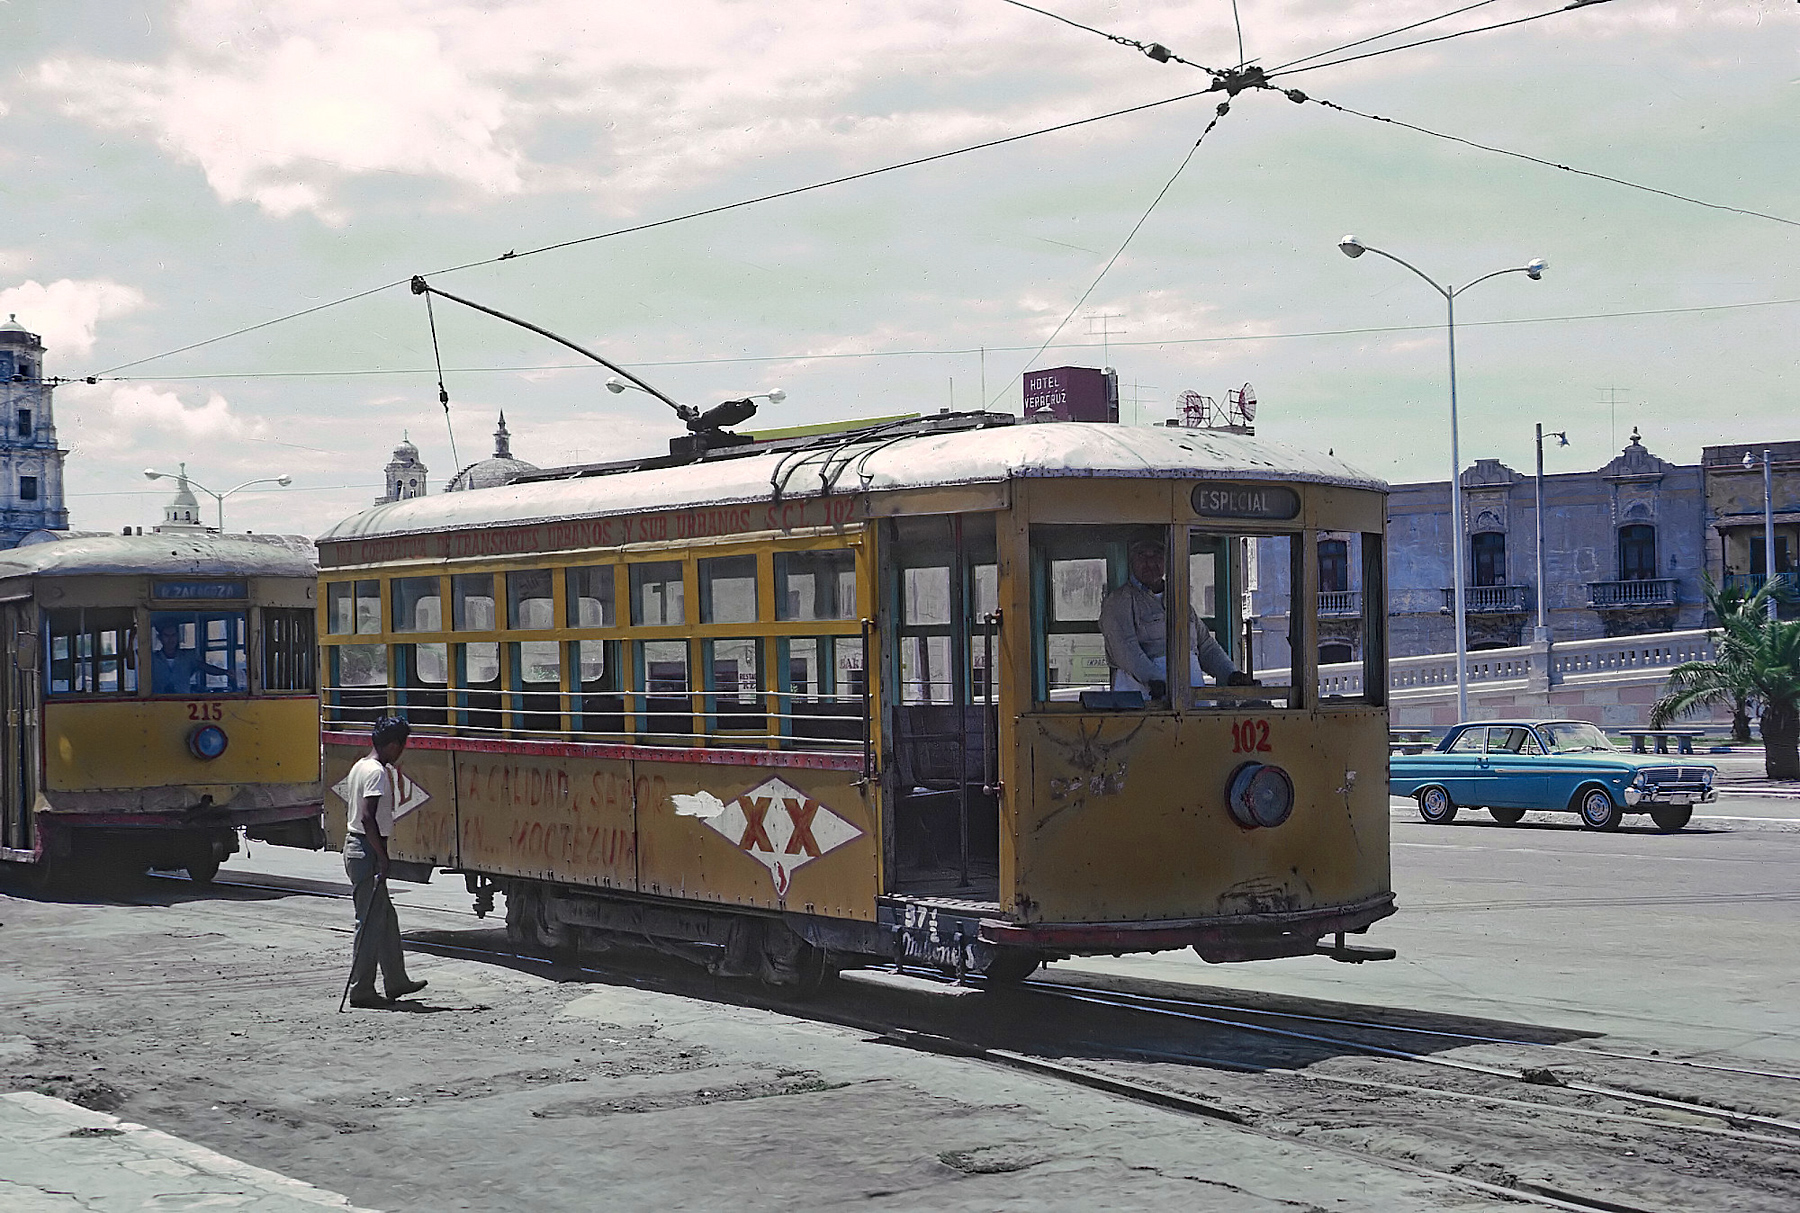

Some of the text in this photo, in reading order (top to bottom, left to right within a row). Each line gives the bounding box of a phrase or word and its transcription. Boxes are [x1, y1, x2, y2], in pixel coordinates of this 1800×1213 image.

[1030, 375, 1060, 391] HOTEL
[1024, 392, 1067, 409] VERACRUZ
[1200, 489, 1270, 512] ESPECIAL
[455, 529, 539, 556] TRANSPORTES
[547, 520, 613, 549] URBANOS
[624, 518, 635, 542] Y
[639, 517, 667, 541] SUB
[676, 508, 751, 540] URBANOS
[824, 499, 856, 525] 102
[187, 703, 223, 721] 215
[1231, 719, 1272, 753] 102
[738, 795, 823, 858] XX
